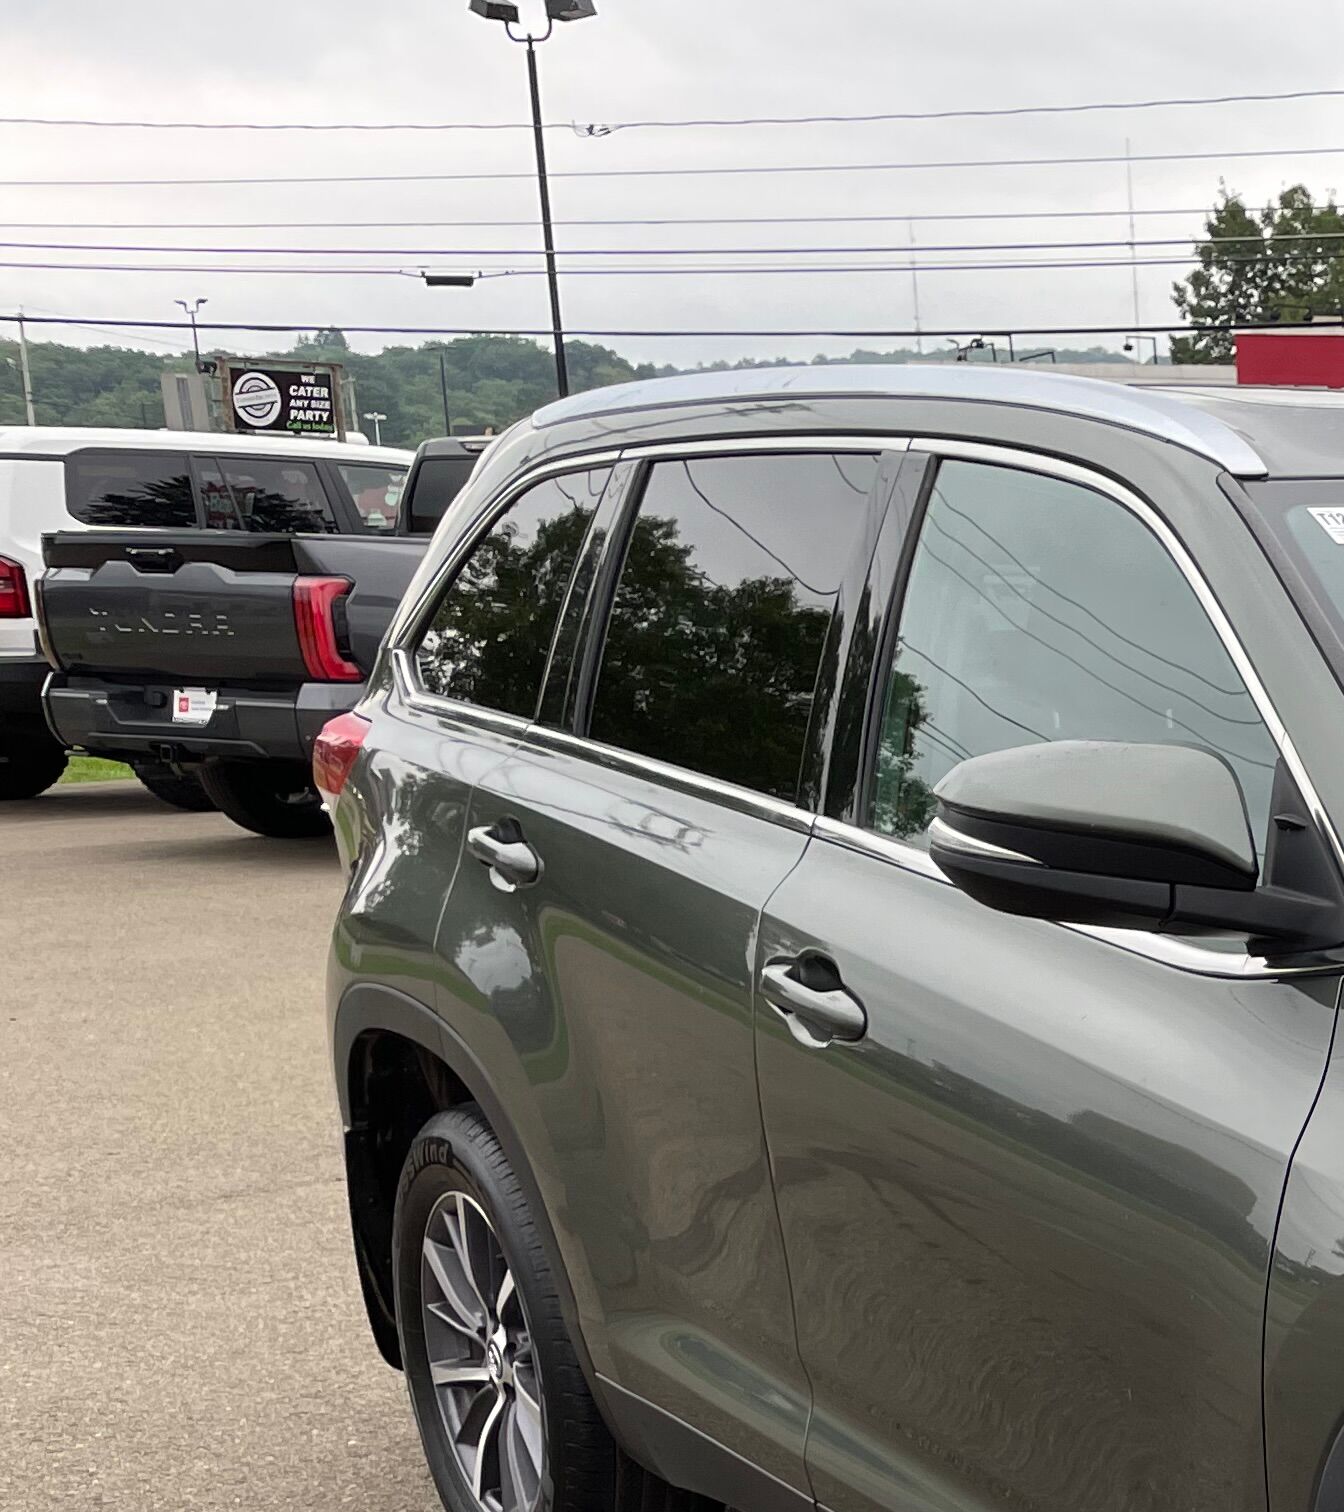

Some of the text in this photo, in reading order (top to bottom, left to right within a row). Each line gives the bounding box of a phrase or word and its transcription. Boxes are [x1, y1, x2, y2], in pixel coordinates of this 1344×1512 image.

[301, 375, 315, 384] WE
[289, 385, 329, 398] CATER
[290, 399, 331, 409] ANY SIZE
[290, 409, 330, 421] PARTY
